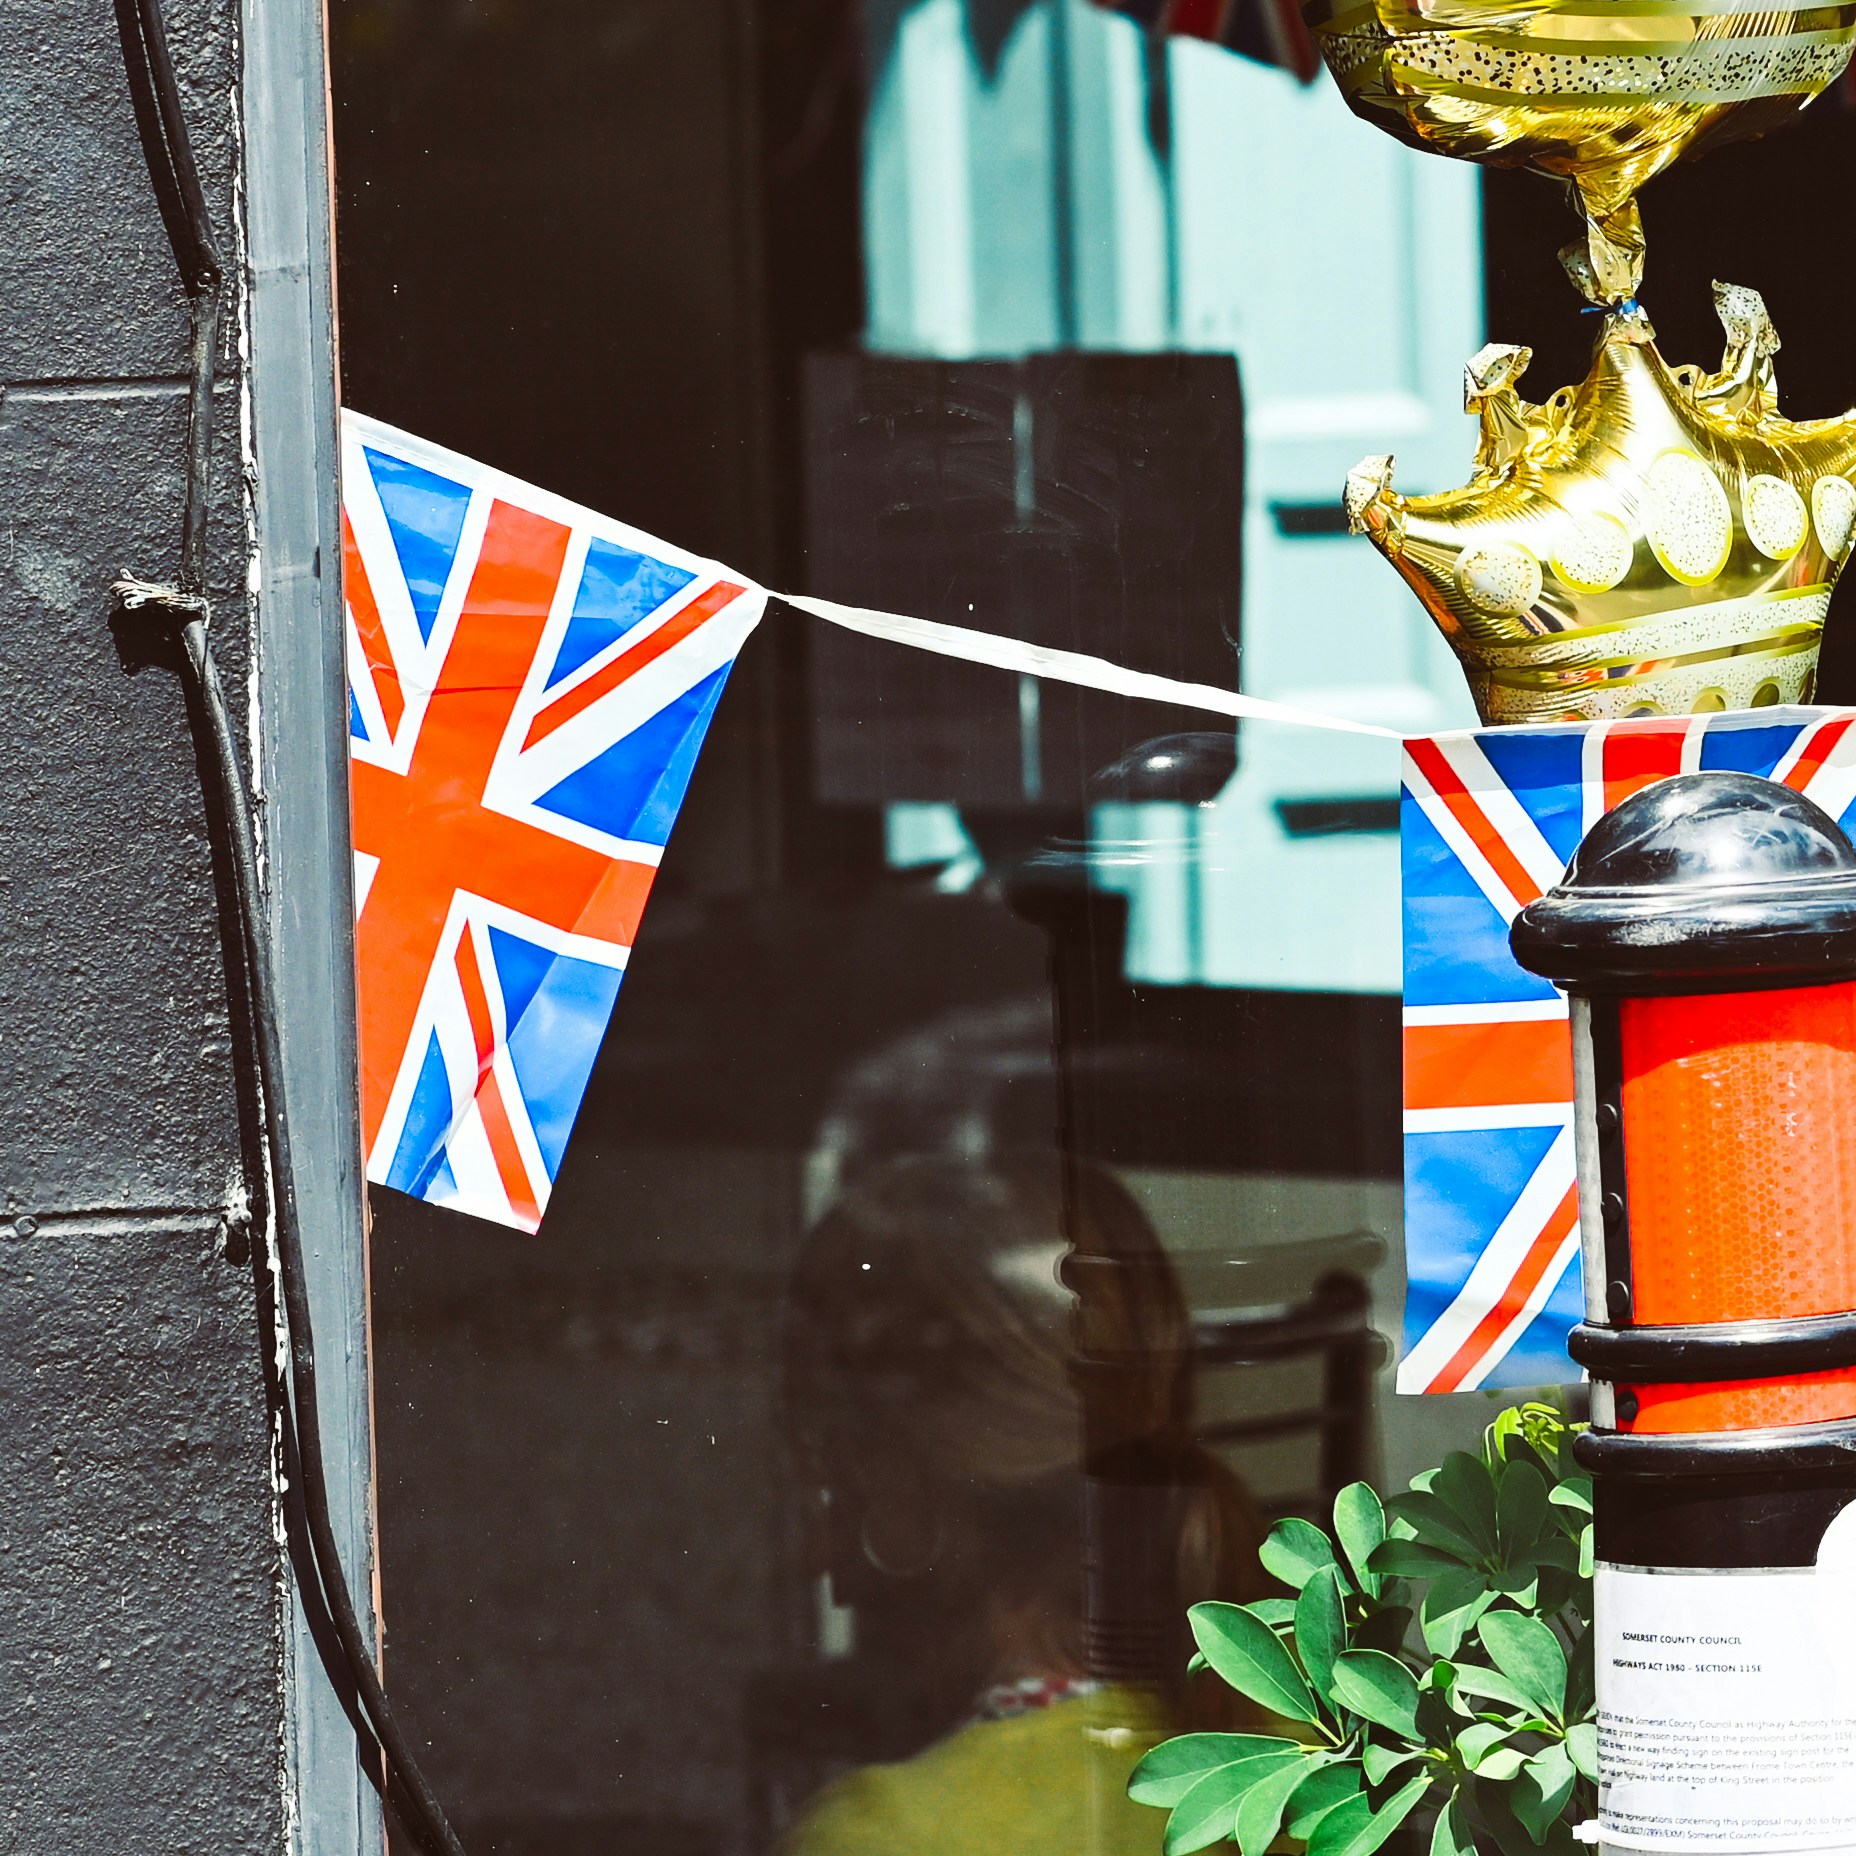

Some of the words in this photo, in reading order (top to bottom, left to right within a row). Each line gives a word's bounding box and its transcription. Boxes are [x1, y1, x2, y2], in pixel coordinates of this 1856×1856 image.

[1622, 1631, 1658, 1643] SOMERSET
[1660, 1635, 1696, 1644] COUNTY
[1699, 1636, 1742, 1645] COUNCIL
[1612, 1658, 1646, 1670] HIGHWAYS
[1648, 1662, 1663, 1671] ACT
[1695, 1664, 1736, 1672] SECTION
[1740, 1664, 1762, 1672] 115E
[1636, 1716, 1667, 1727] Somerset
[1669, 1718, 1696, 1730] County
[1699, 1719, 1731, 1729] Council
[1673, 1734, 1709, 1743] pursuant
